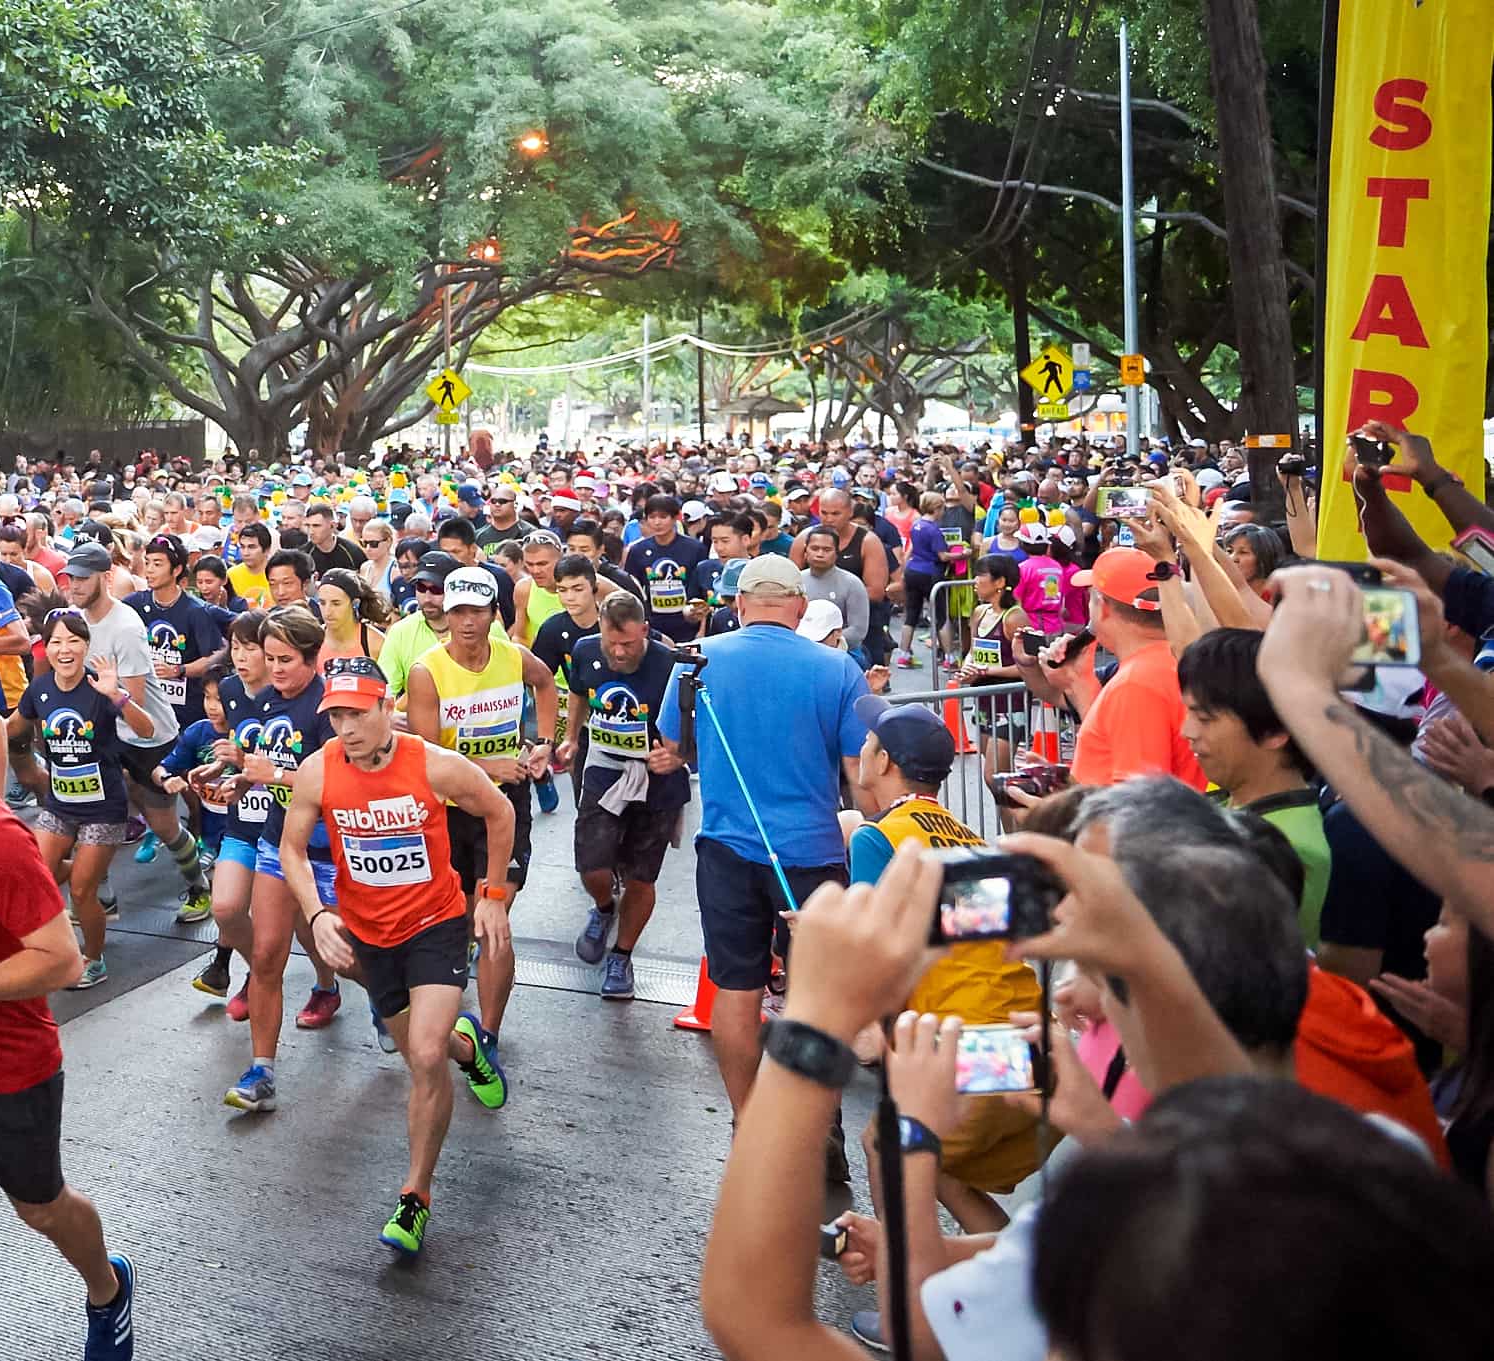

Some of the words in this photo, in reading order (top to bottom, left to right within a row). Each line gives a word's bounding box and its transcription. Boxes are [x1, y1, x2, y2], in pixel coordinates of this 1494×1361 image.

[1040, 406, 1065, 416] AHEAD
[459, 736, 517, 757] 91034
[591, 729, 646, 749] 50145
[349, 851, 426, 875] 50025
